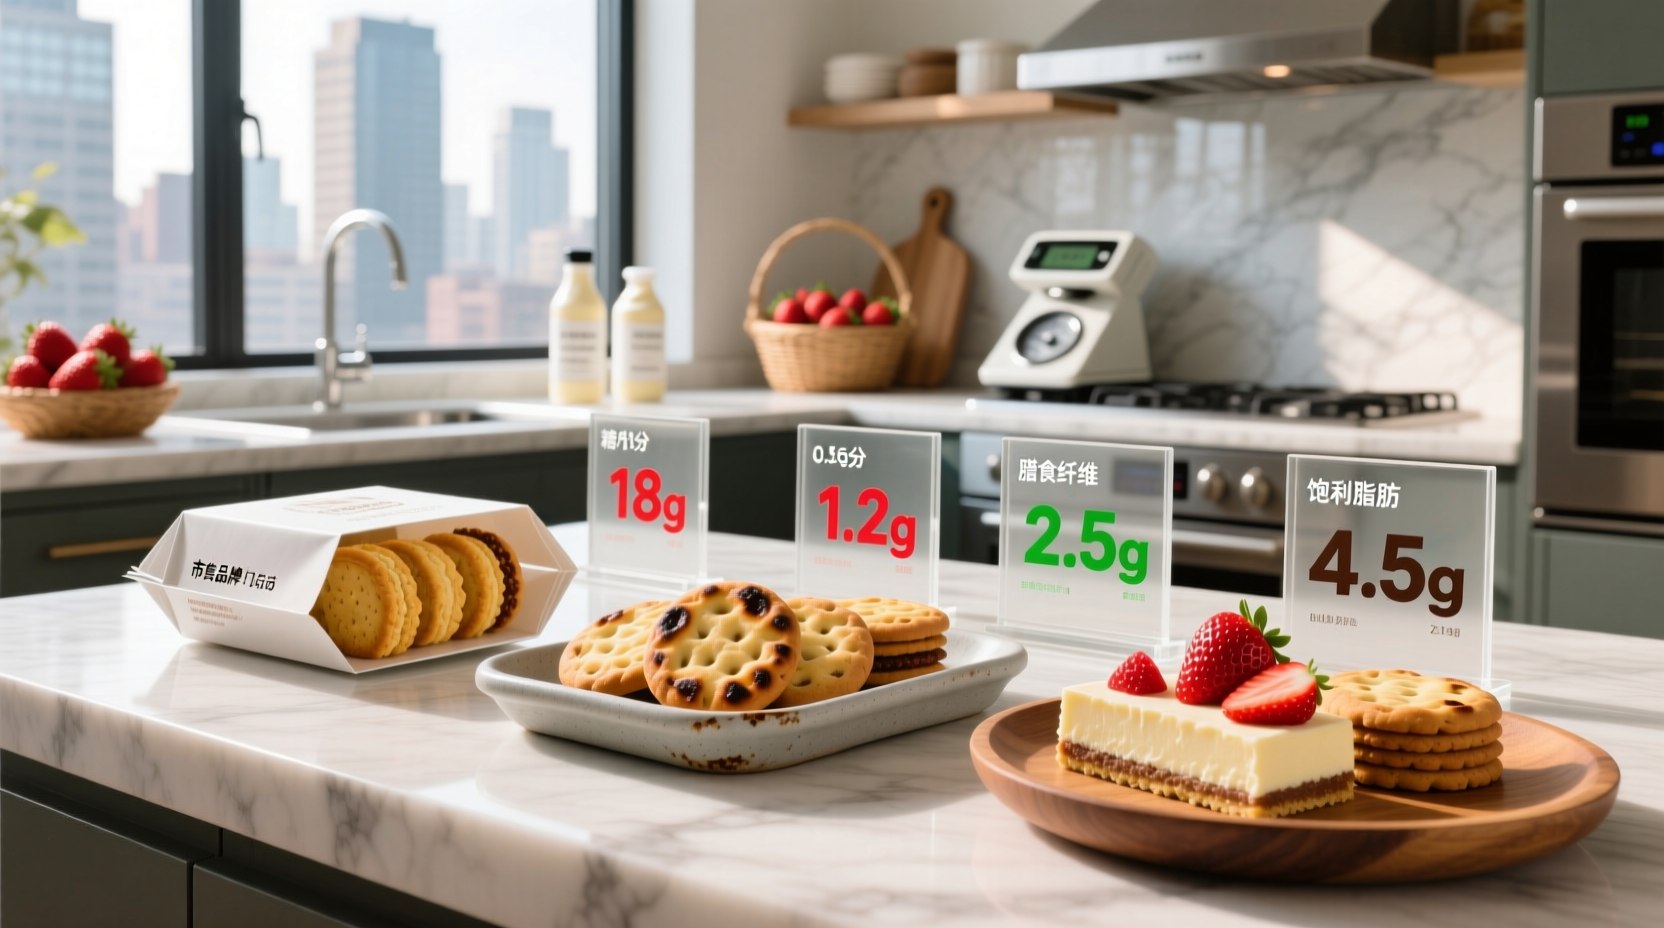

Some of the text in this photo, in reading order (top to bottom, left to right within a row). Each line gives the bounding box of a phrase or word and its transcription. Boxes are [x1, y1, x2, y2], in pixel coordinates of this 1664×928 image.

[609, 467, 687, 534] 18g
[818, 485, 917, 559] 1.2g
[1306, 477, 1402, 509] 饱利脂肪
[1024, 504, 1149, 585] 2.5g
[1308, 529, 1465, 618] 4.5g
